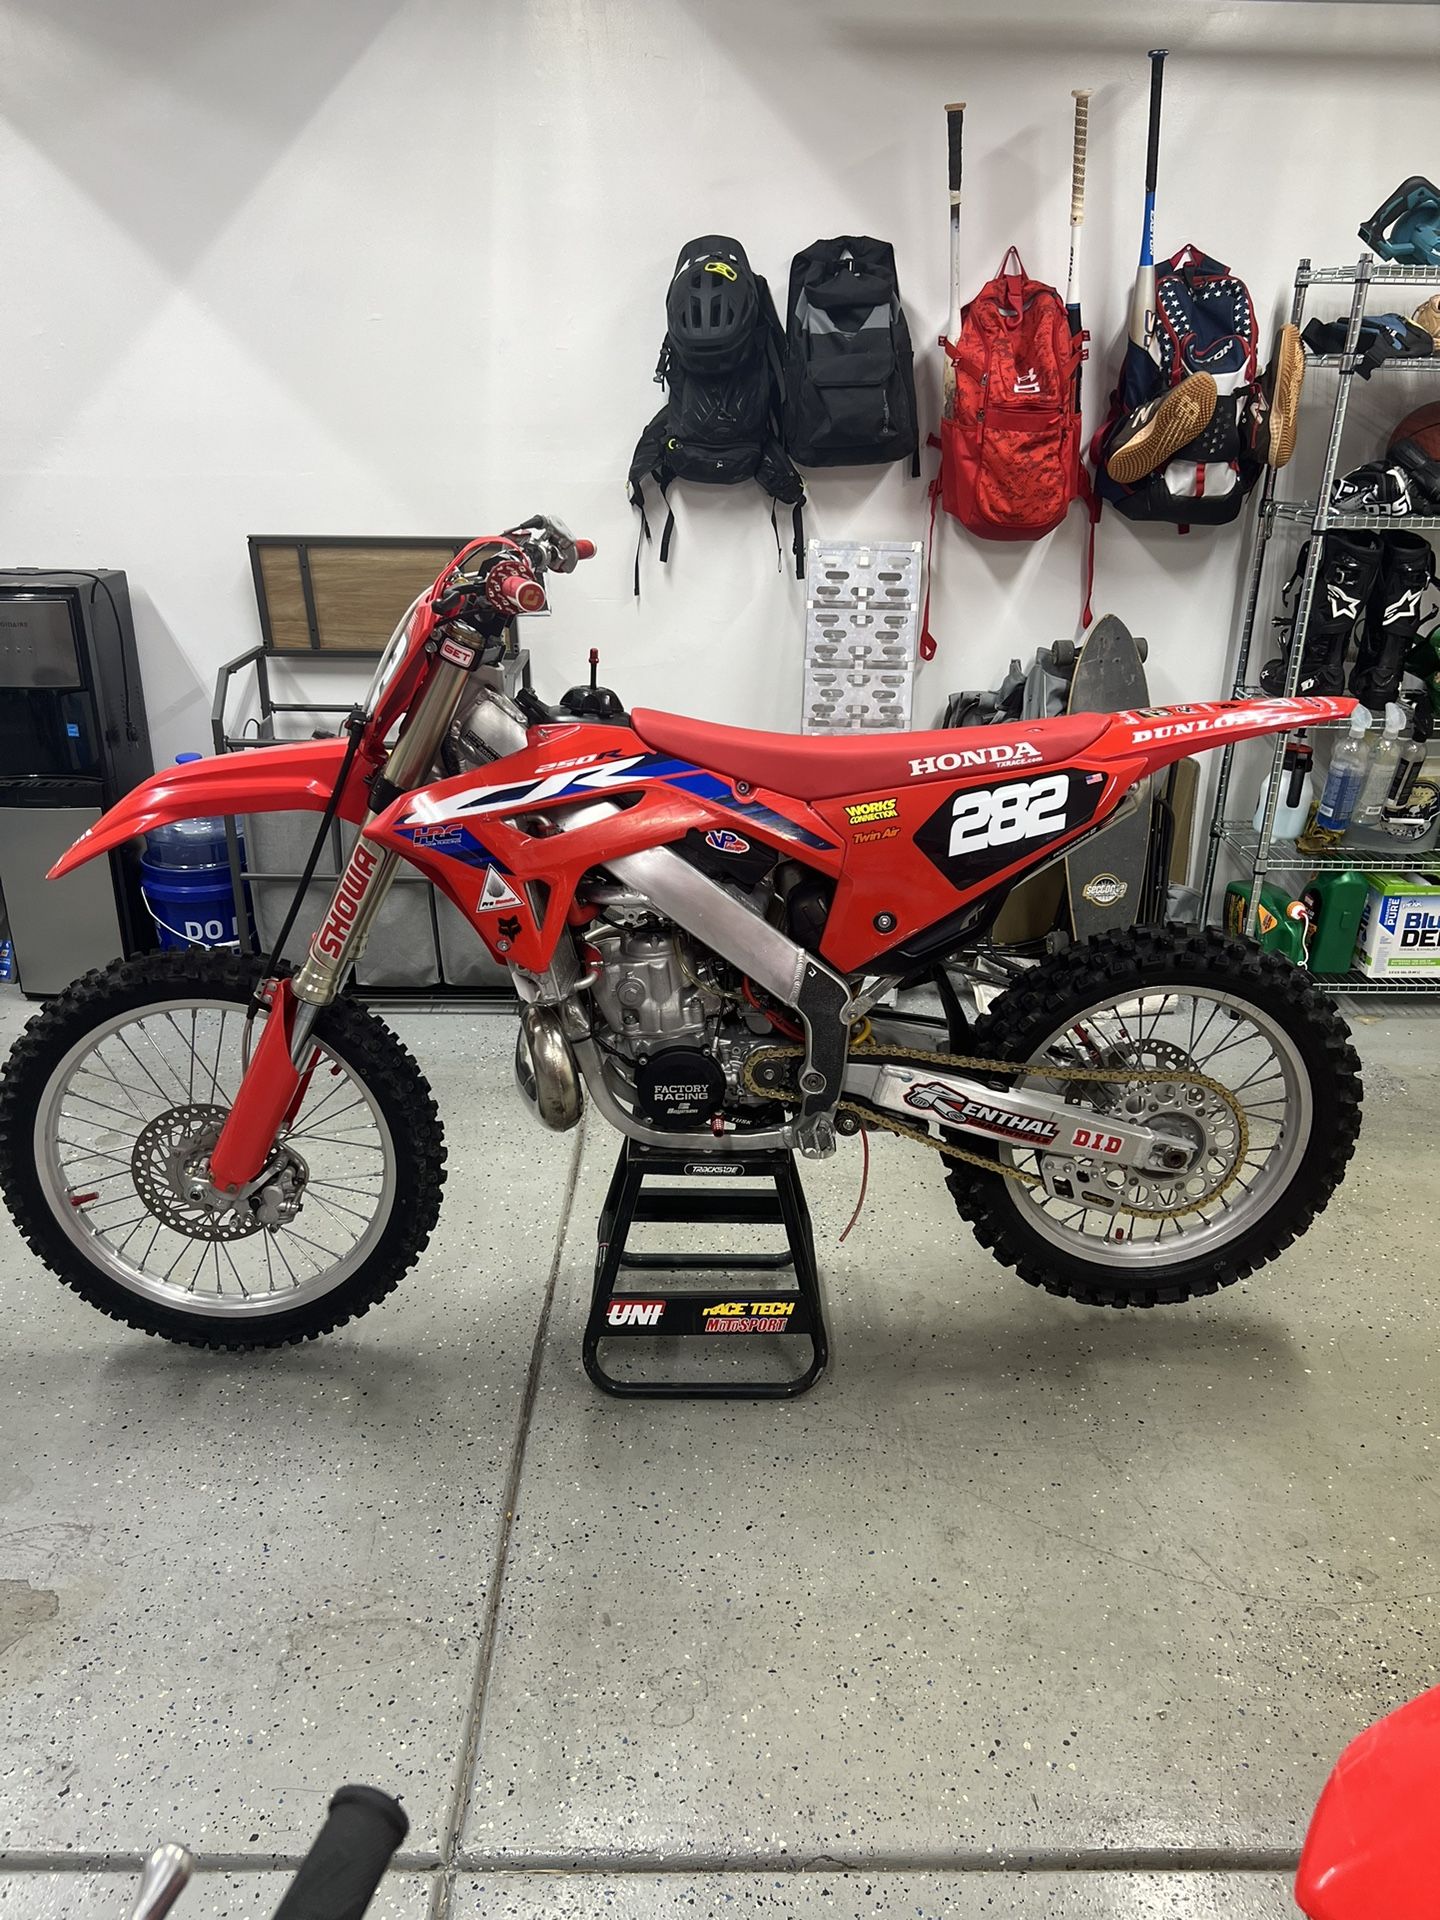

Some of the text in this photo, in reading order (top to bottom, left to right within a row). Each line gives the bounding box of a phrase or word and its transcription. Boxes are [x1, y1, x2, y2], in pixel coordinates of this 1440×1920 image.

[445, 646, 471, 662] GET
[908, 742, 1041, 776] HONDA
[845, 799, 897, 816] WORKS
[850, 809, 898, 824] CONNECTION
[949, 775, 1069, 857] 282
[413, 824, 463, 845] HRC
[709, 830, 738, 849] VP
[854, 827, 900, 843] Twin Air
[320, 844, 378, 959] SHOWA
[1388, 899, 1400, 926] PURE
[185, 920, 224, 940] DO
[1400, 930, 1440, 947] DE
[654, 1085, 709, 1093] FACTORY
[654, 1092, 708, 1100] RACING
[1073, 1129, 1122, 1153] D.I.D
[692, 1166, 738, 1174] TRACKSIDE
[607, 1304, 664, 1326] UNI
[702, 1302, 795, 1316] RACE TECH
